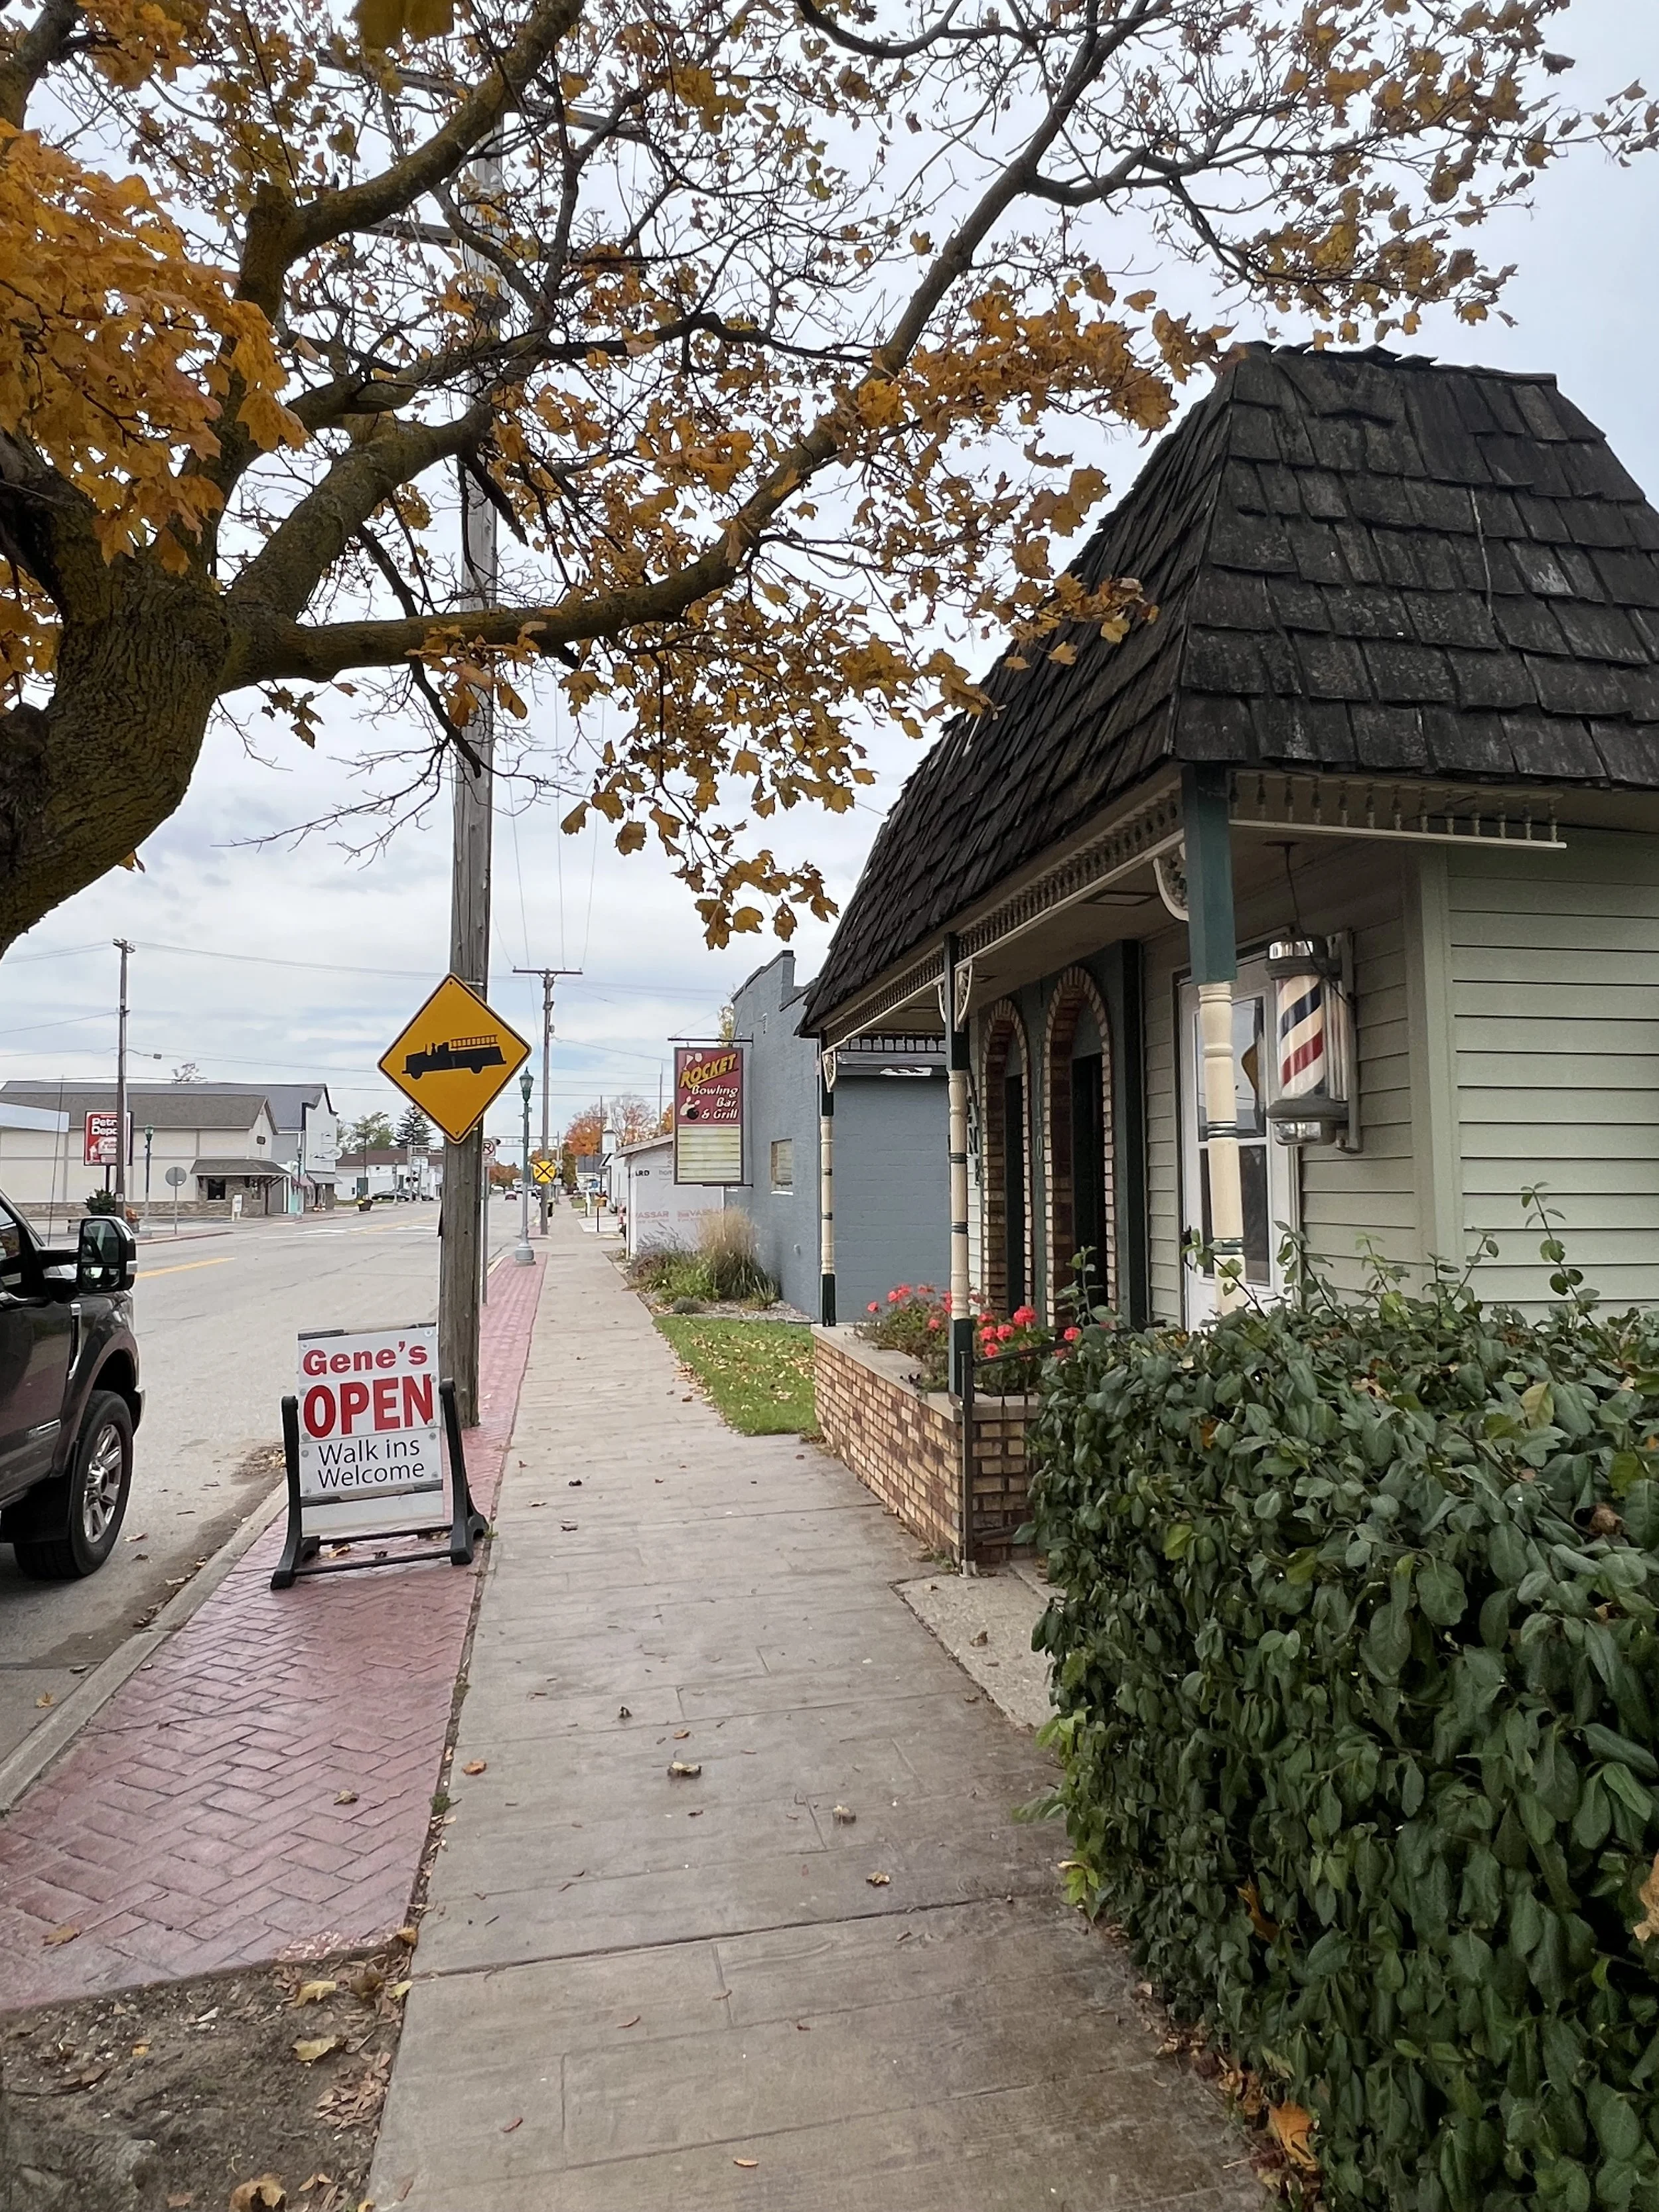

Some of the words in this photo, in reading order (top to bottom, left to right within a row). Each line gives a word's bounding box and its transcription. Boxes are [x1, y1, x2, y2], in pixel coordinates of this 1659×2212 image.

[680, 1053, 737, 1088] ROCKET
[691, 1084, 738, 1098] Bowling
[716, 1096, 737, 1107] Bar
[92, 1118, 117, 1126] Petr
[701, 1108, 710, 1120] &
[713, 1108, 738, 1119] Grill
[92, 1126, 117, 1136] Depo
[303, 1341, 428, 1376] Gene's
[303, 1374, 433, 1438] OPEN
[318, 1439, 379, 1466] Walk
[386, 1439, 420, 1458] ins
[317, 1462, 425, 1489] Welcome
